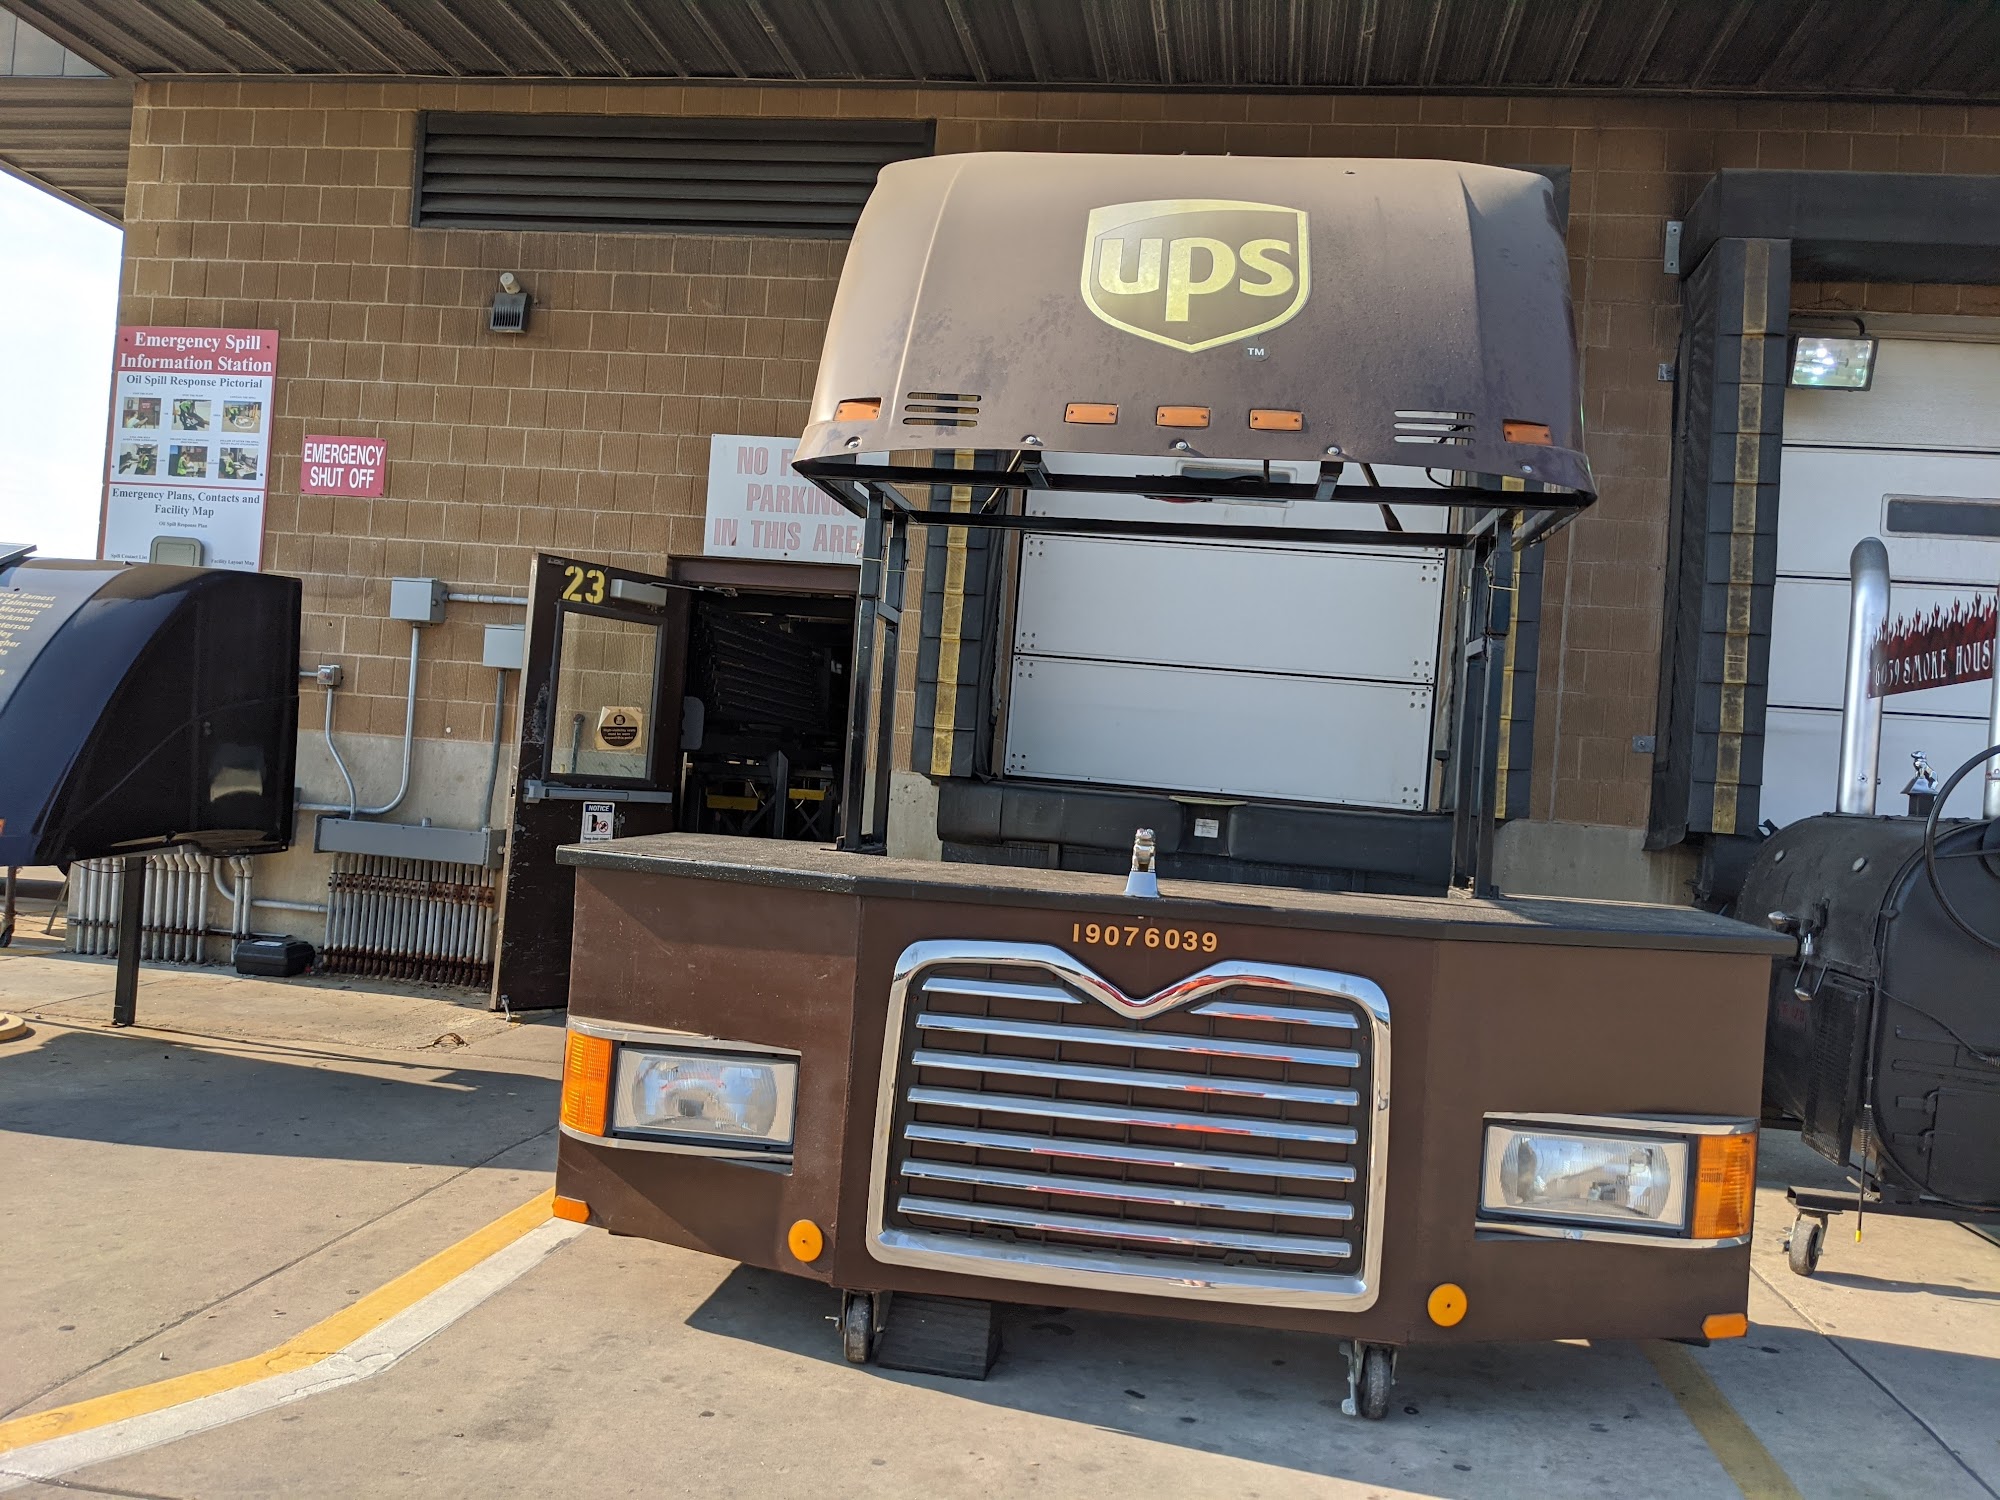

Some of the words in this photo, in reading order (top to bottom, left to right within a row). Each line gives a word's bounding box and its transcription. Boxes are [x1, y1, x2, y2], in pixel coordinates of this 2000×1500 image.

[1098, 237, 1294, 321] ups
[134, 331, 221, 352] Emergency
[225, 334, 261, 353] Spill
[1247, 347, 1265, 356] TM
[120, 353, 213, 370] Information
[217, 356, 272, 372] Station
[126, 374, 142, 384] Oil
[144, 375, 167, 386] Spill
[170, 376, 217, 388] Response
[219, 378, 263, 388] Pictorial
[303, 443, 384, 466] EMERGENCY
[736, 446, 769, 476] NO
[309, 465, 344, 487] SHUT
[349, 468, 375, 489] OFF
[112, 488, 165, 501] Emergency
[167, 490, 196, 502] Plans,
[198, 492, 239, 503] Contacts
[242, 495, 260, 504] and
[154, 504, 190, 517] Facility
[192, 506, 215, 518] Map
[713, 518, 738, 546] IN
[751, 520, 801, 550] THIS
[813, 524, 864, 554] ARE
[562, 565, 605, 604] 23
[20, 593, 56, 602] Earnest
[1903, 648, 1947, 684] SMOKE
[1072, 923, 1218, 953] 19076039
